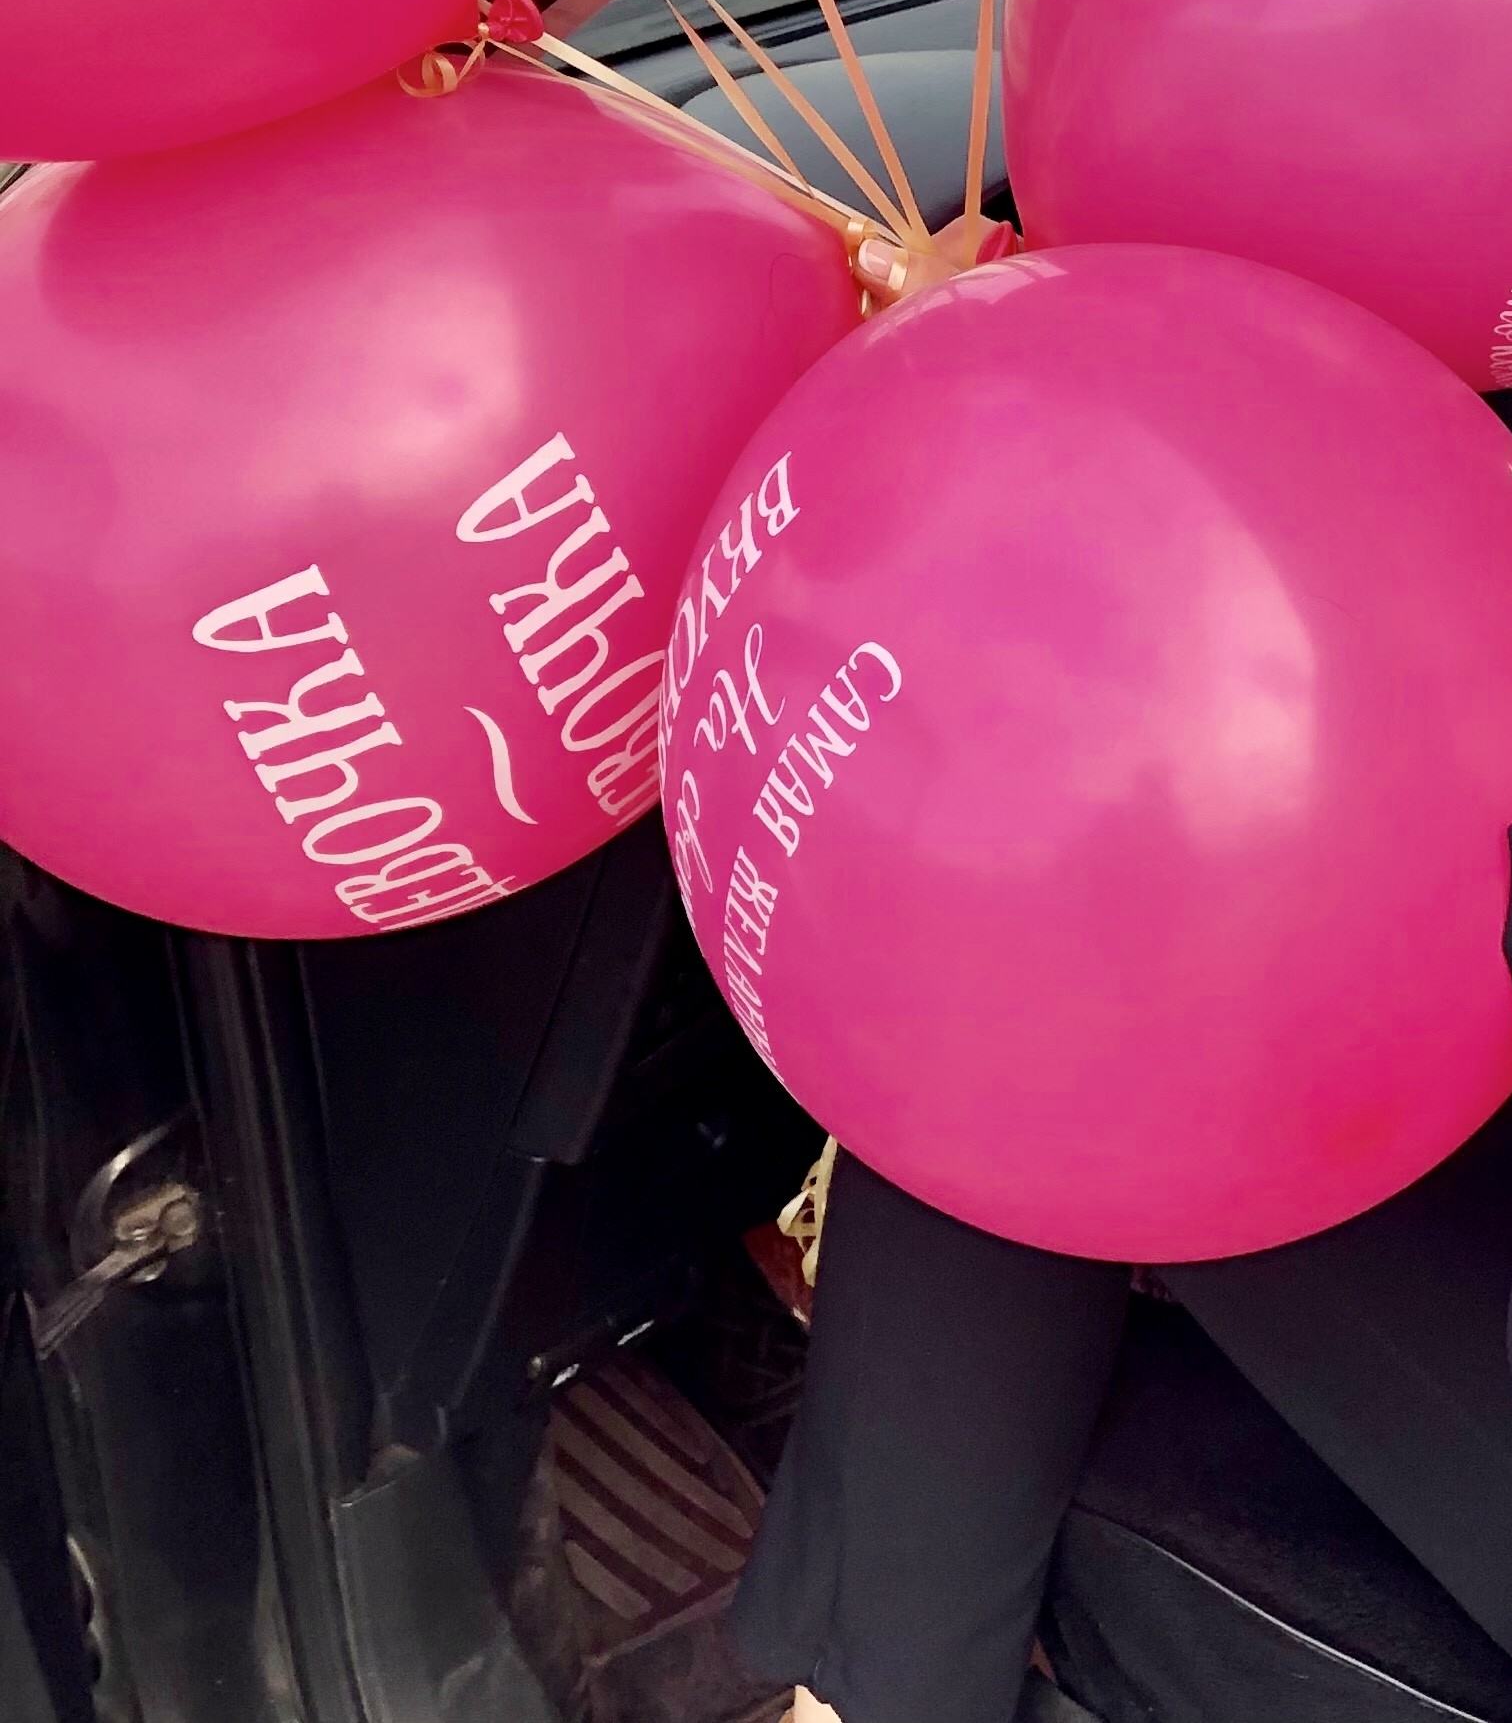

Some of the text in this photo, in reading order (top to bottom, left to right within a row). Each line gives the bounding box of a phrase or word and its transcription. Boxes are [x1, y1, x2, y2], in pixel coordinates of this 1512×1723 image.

[192, 563, 516, 931] ЕВОЧКА
[455, 432, 666, 826] ЕВОЧКА
[693, 622, 787, 756] На
[753, 640, 902, 857] САМАЯ
